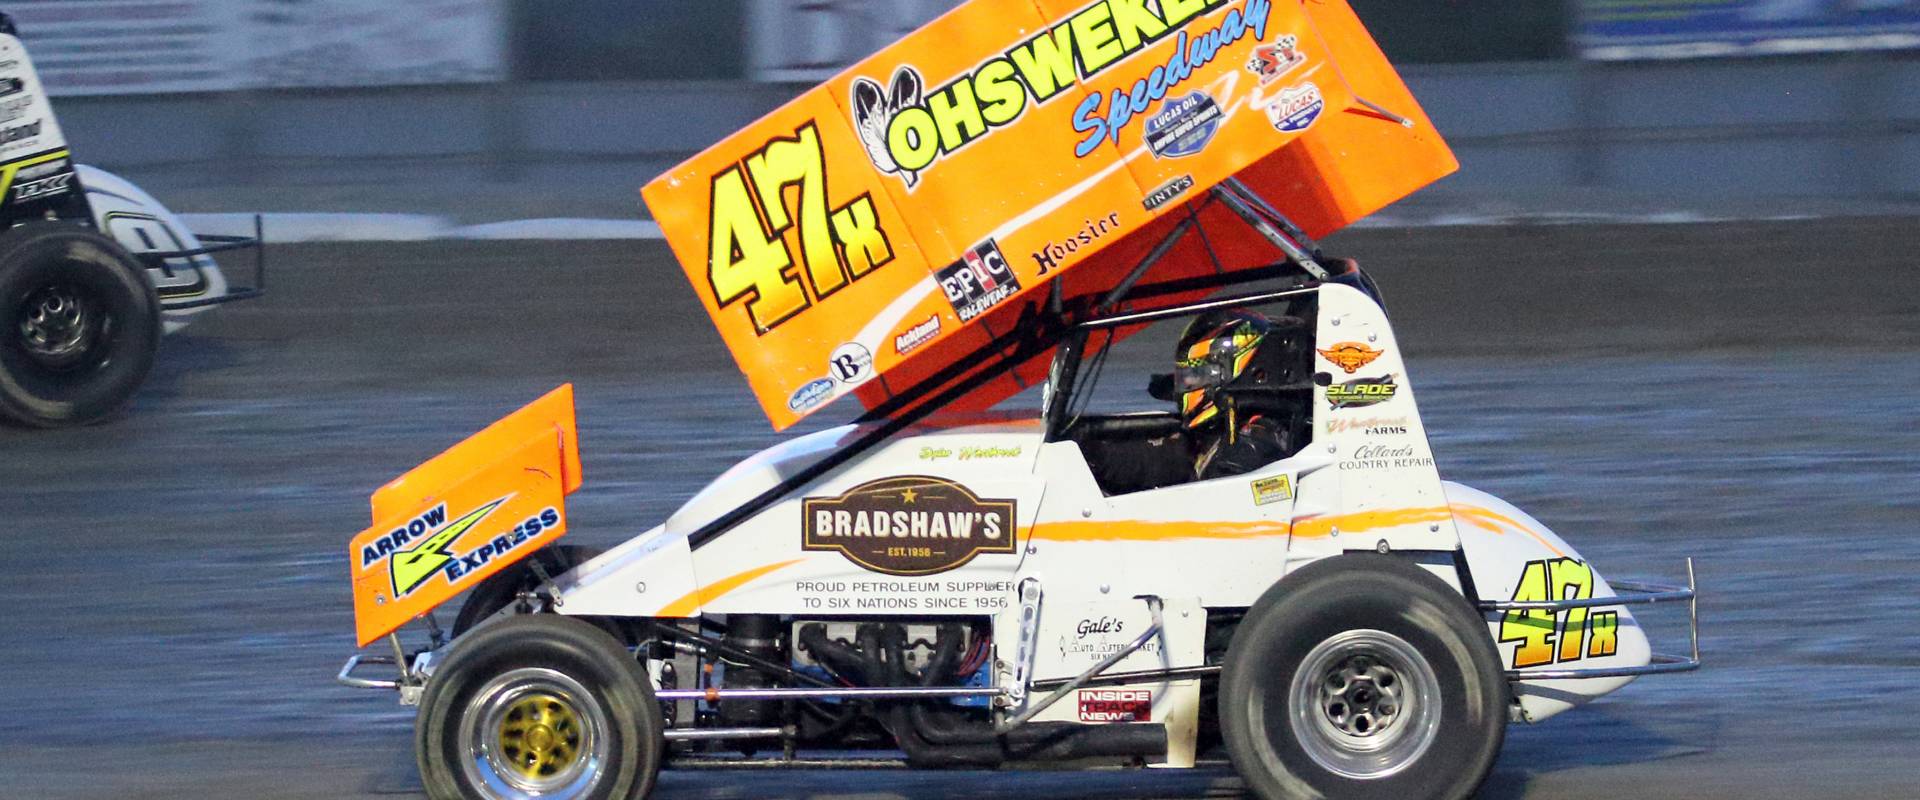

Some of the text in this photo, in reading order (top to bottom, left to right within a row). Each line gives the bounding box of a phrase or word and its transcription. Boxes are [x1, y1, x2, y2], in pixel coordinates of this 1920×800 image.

[1072, 0, 1271, 158] Speedway
[1154, 104, 1182, 129] LUCAS
[1182, 95, 1198, 110] OIL
[707, 117, 896, 336] 47x
[1032, 212, 1119, 276] Hoosier
[941, 250, 1005, 302] EPIC
[1325, 383, 1397, 396] SLADE
[1365, 426, 1408, 436] FARMS
[1338, 457, 1433, 471] COUNTRY REPAIR
[362, 504, 447, 567] ARROW
[816, 510, 1002, 540] BRADSHAW'S
[443, 508, 560, 583] EXPRESS
[796, 581, 1016, 593] PROUD PETROLEUM SUPPLER
[803, 597, 1009, 609] TO SIX NATIONS SINCE 1956
[1497, 555, 1620, 669] 47x
[1076, 615, 1123, 639] Gale's
[1080, 691, 1150, 702] INSIDE
[1080, 712, 1137, 721] NEWS
